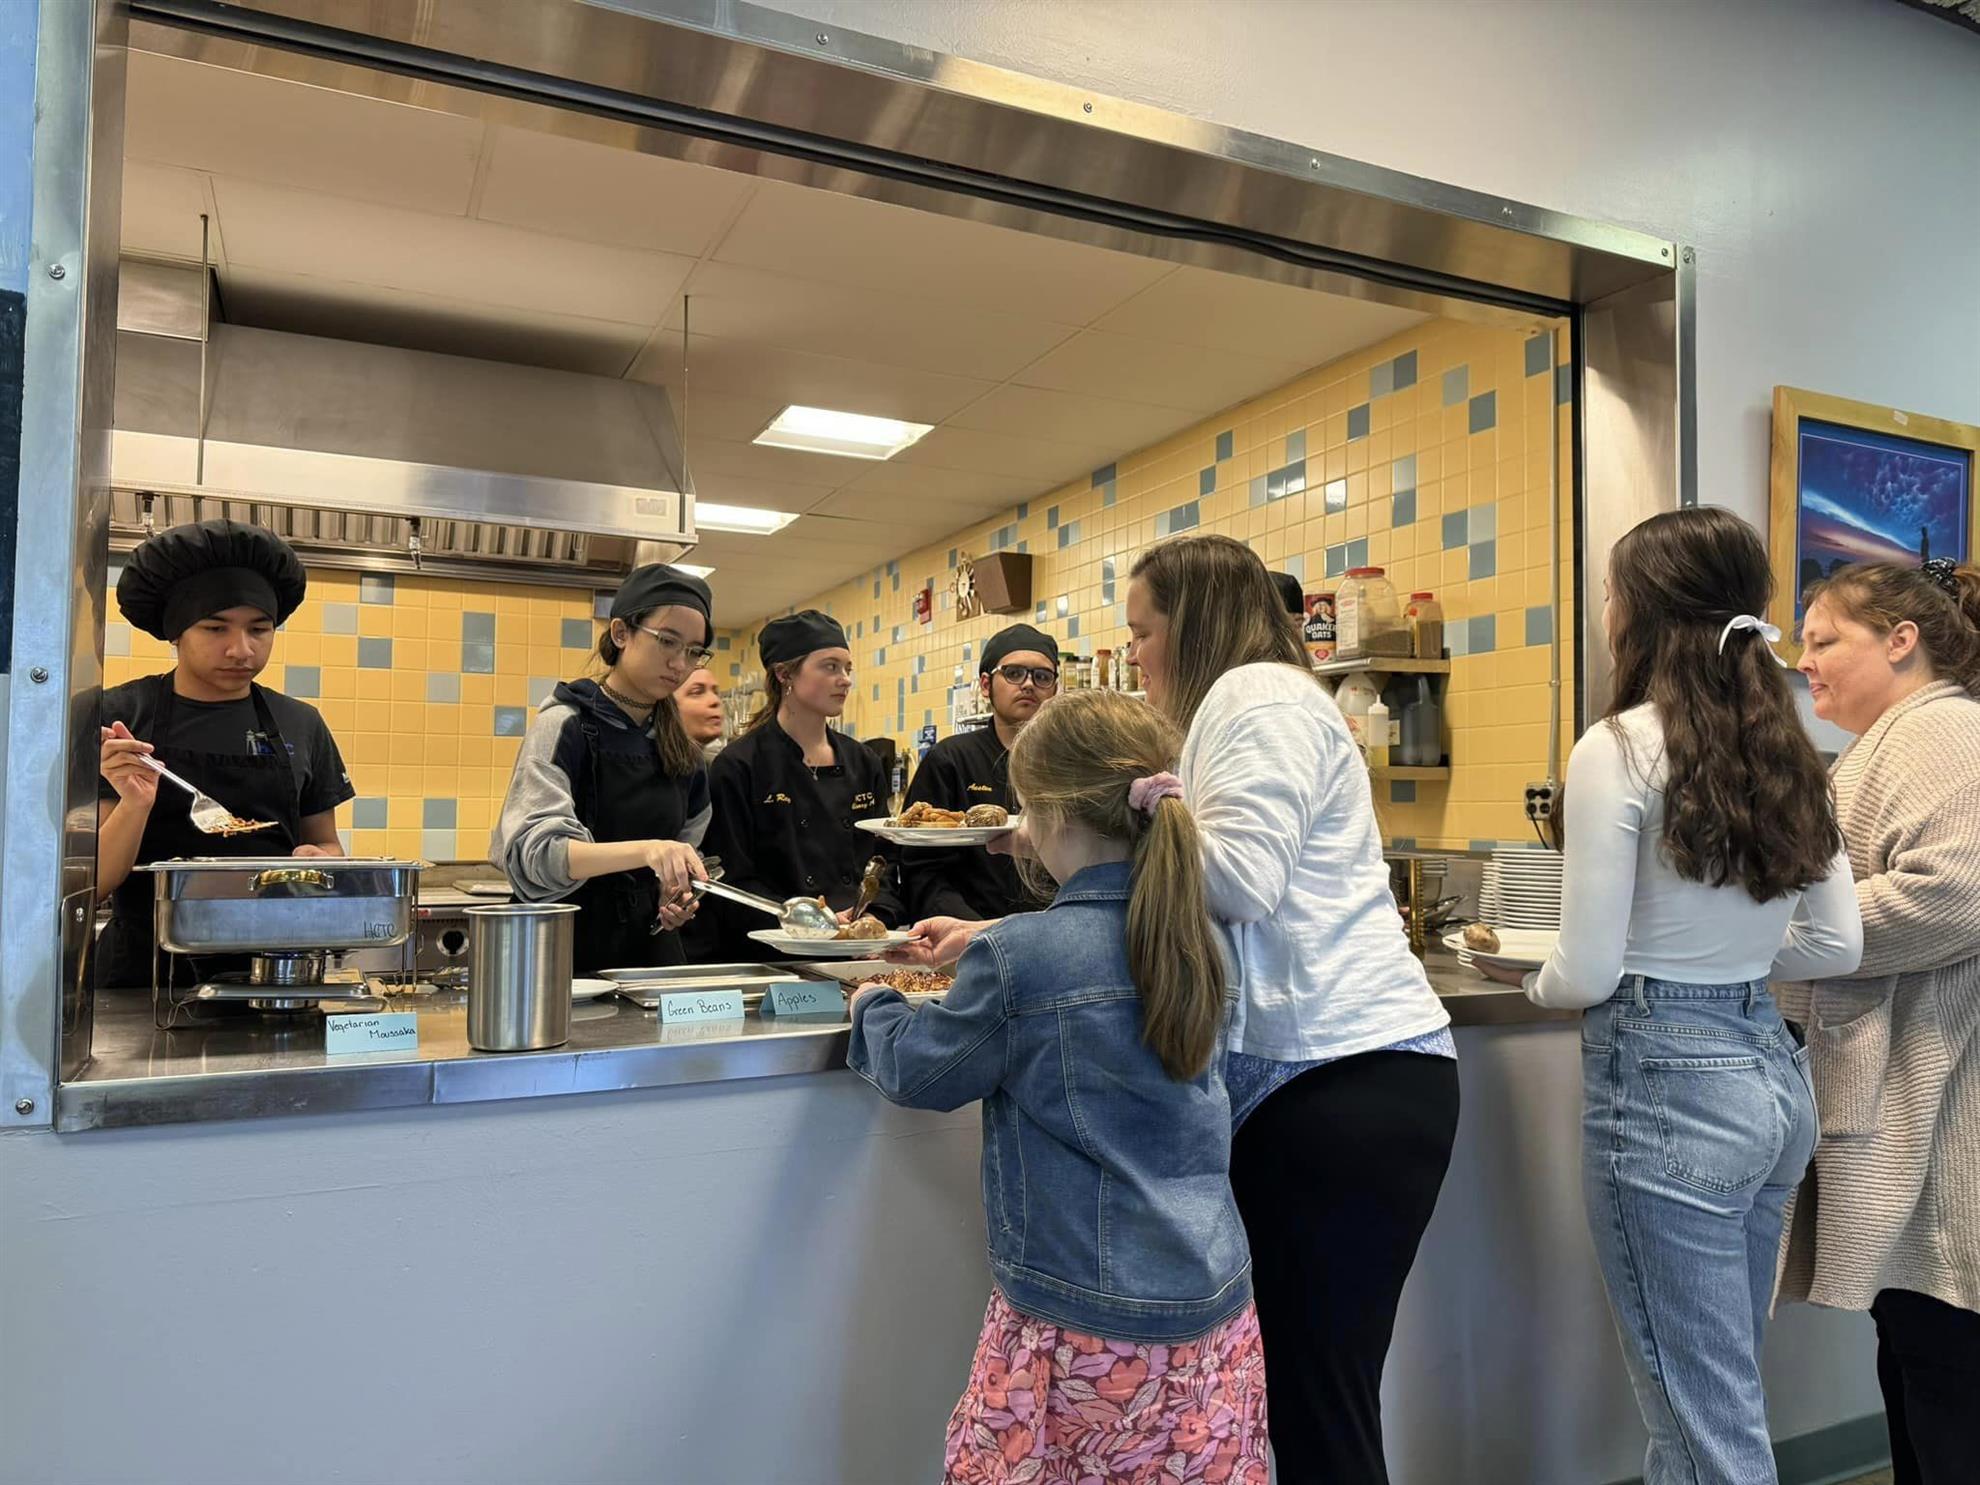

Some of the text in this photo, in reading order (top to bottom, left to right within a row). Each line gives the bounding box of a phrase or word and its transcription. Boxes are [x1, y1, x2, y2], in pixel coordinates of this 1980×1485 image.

[1311, 631, 1332, 639] OATS
[667, 999, 732, 1017] Green Beans
[777, 992, 817, 1012] Apples
[328, 1020, 380, 1033] Vegetarian
[369, 1026, 416, 1039] Moussaka
